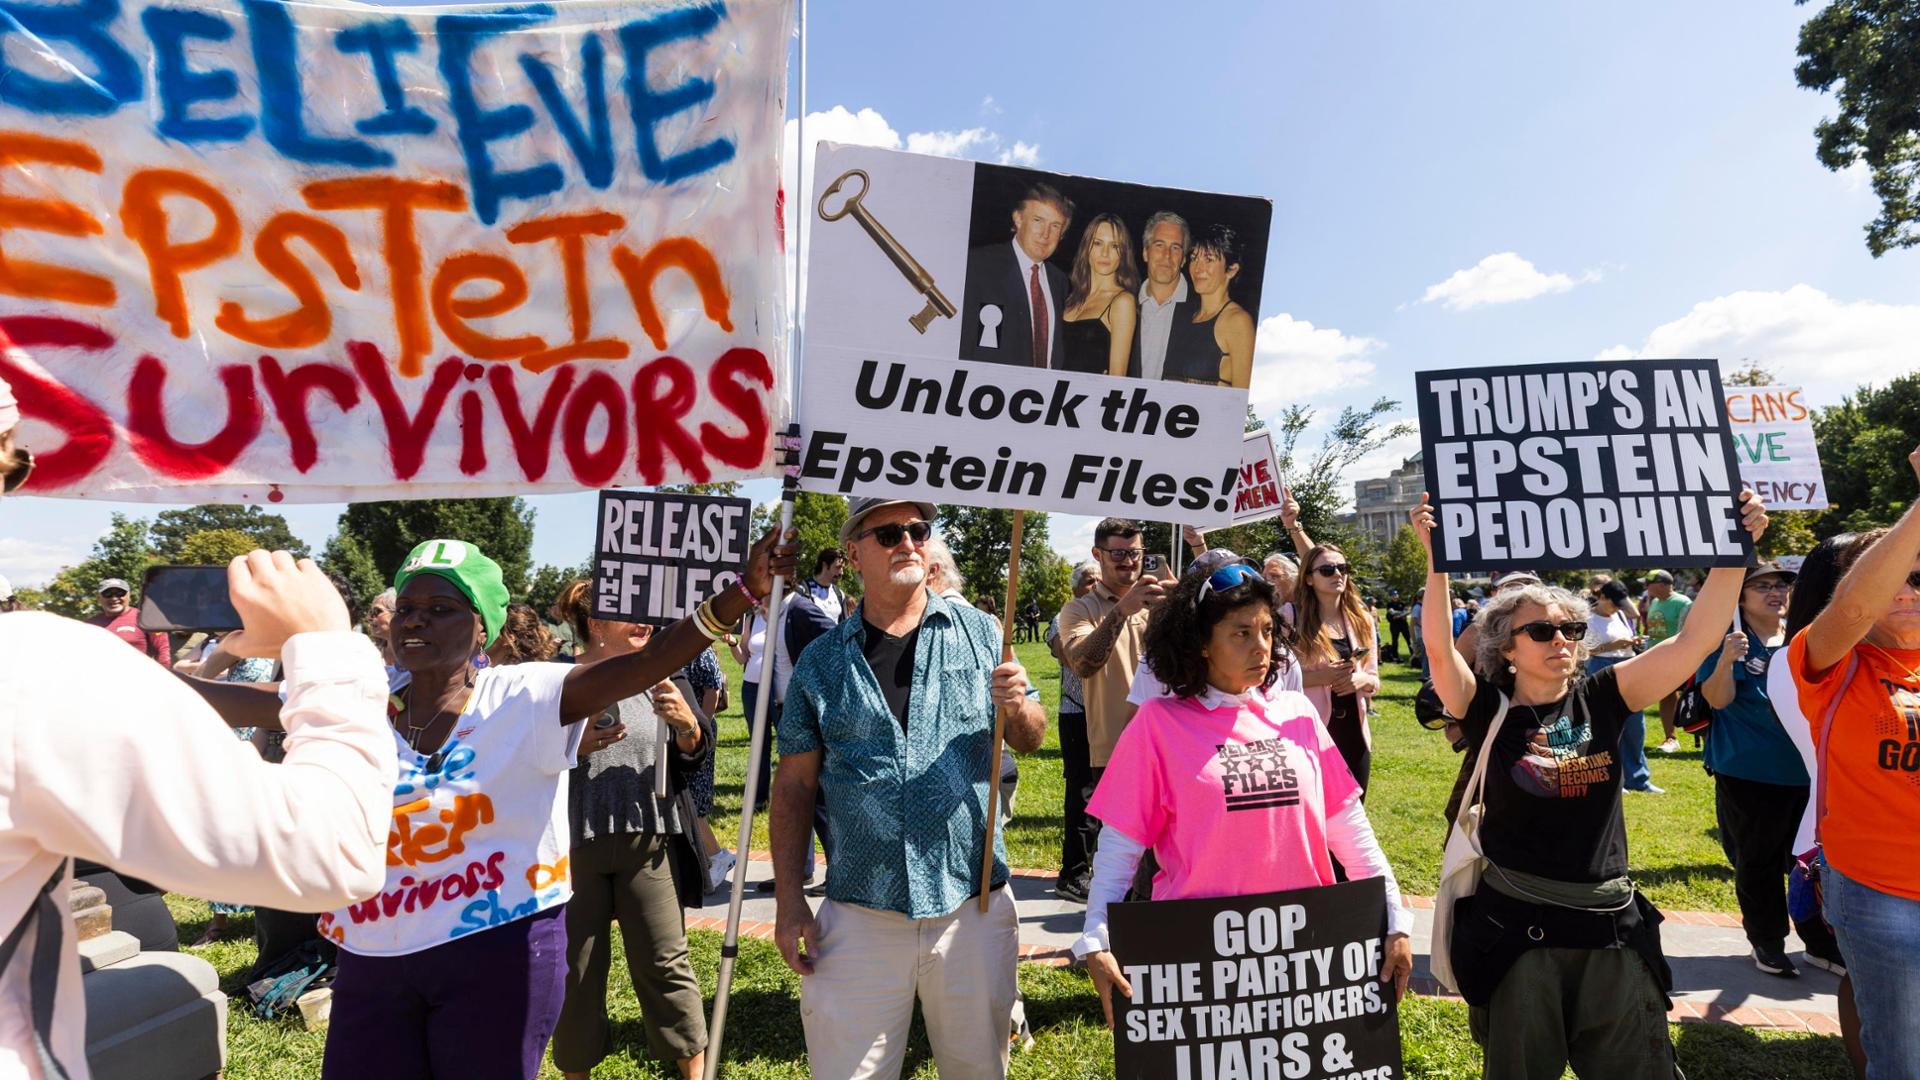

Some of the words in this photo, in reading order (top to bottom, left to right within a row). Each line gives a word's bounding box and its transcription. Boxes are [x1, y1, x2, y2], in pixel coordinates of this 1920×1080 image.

[854, 360, 1086, 429] Unlock
[1100, 388, 1200, 438] the
[1430, 369, 1644, 436] TRUMP'S
[1655, 369, 1718, 428] AN
[1726, 390, 1807, 424] CANS
[803, 430, 1050, 496] Epstein
[1061, 454, 1240, 513] Files!
[1239, 458, 1272, 487] VE
[1434, 432, 1730, 499] EPSTEIN
[1234, 481, 1280, 513] MEN
[1742, 480, 1817, 504] ENCY
[602, 498, 743, 563] RELEASE
[1441, 495, 1744, 561] PEDOPHILE
[432, 543, 453, 564] L
[598, 560, 623, 613] THE
[1216, 738, 1287, 759] RELEASE
[1559, 751, 1613, 773] RESISTANCE
[1221, 769, 1298, 795] FILES
[1560, 767, 1610, 786] BECOMES
[1560, 785, 1588, 798] DUTY
[1213, 904, 1306, 957] GOP
[1124, 962, 1203, 1005] THE
[1212, 946, 1334, 1000] PARTY
[1342, 937, 1382, 982] OF
[1126, 1007, 1185, 1043] SEX
[1191, 981, 1388, 1037] TRAFFICKERS,
[1322, 1032, 1354, 1073] &
